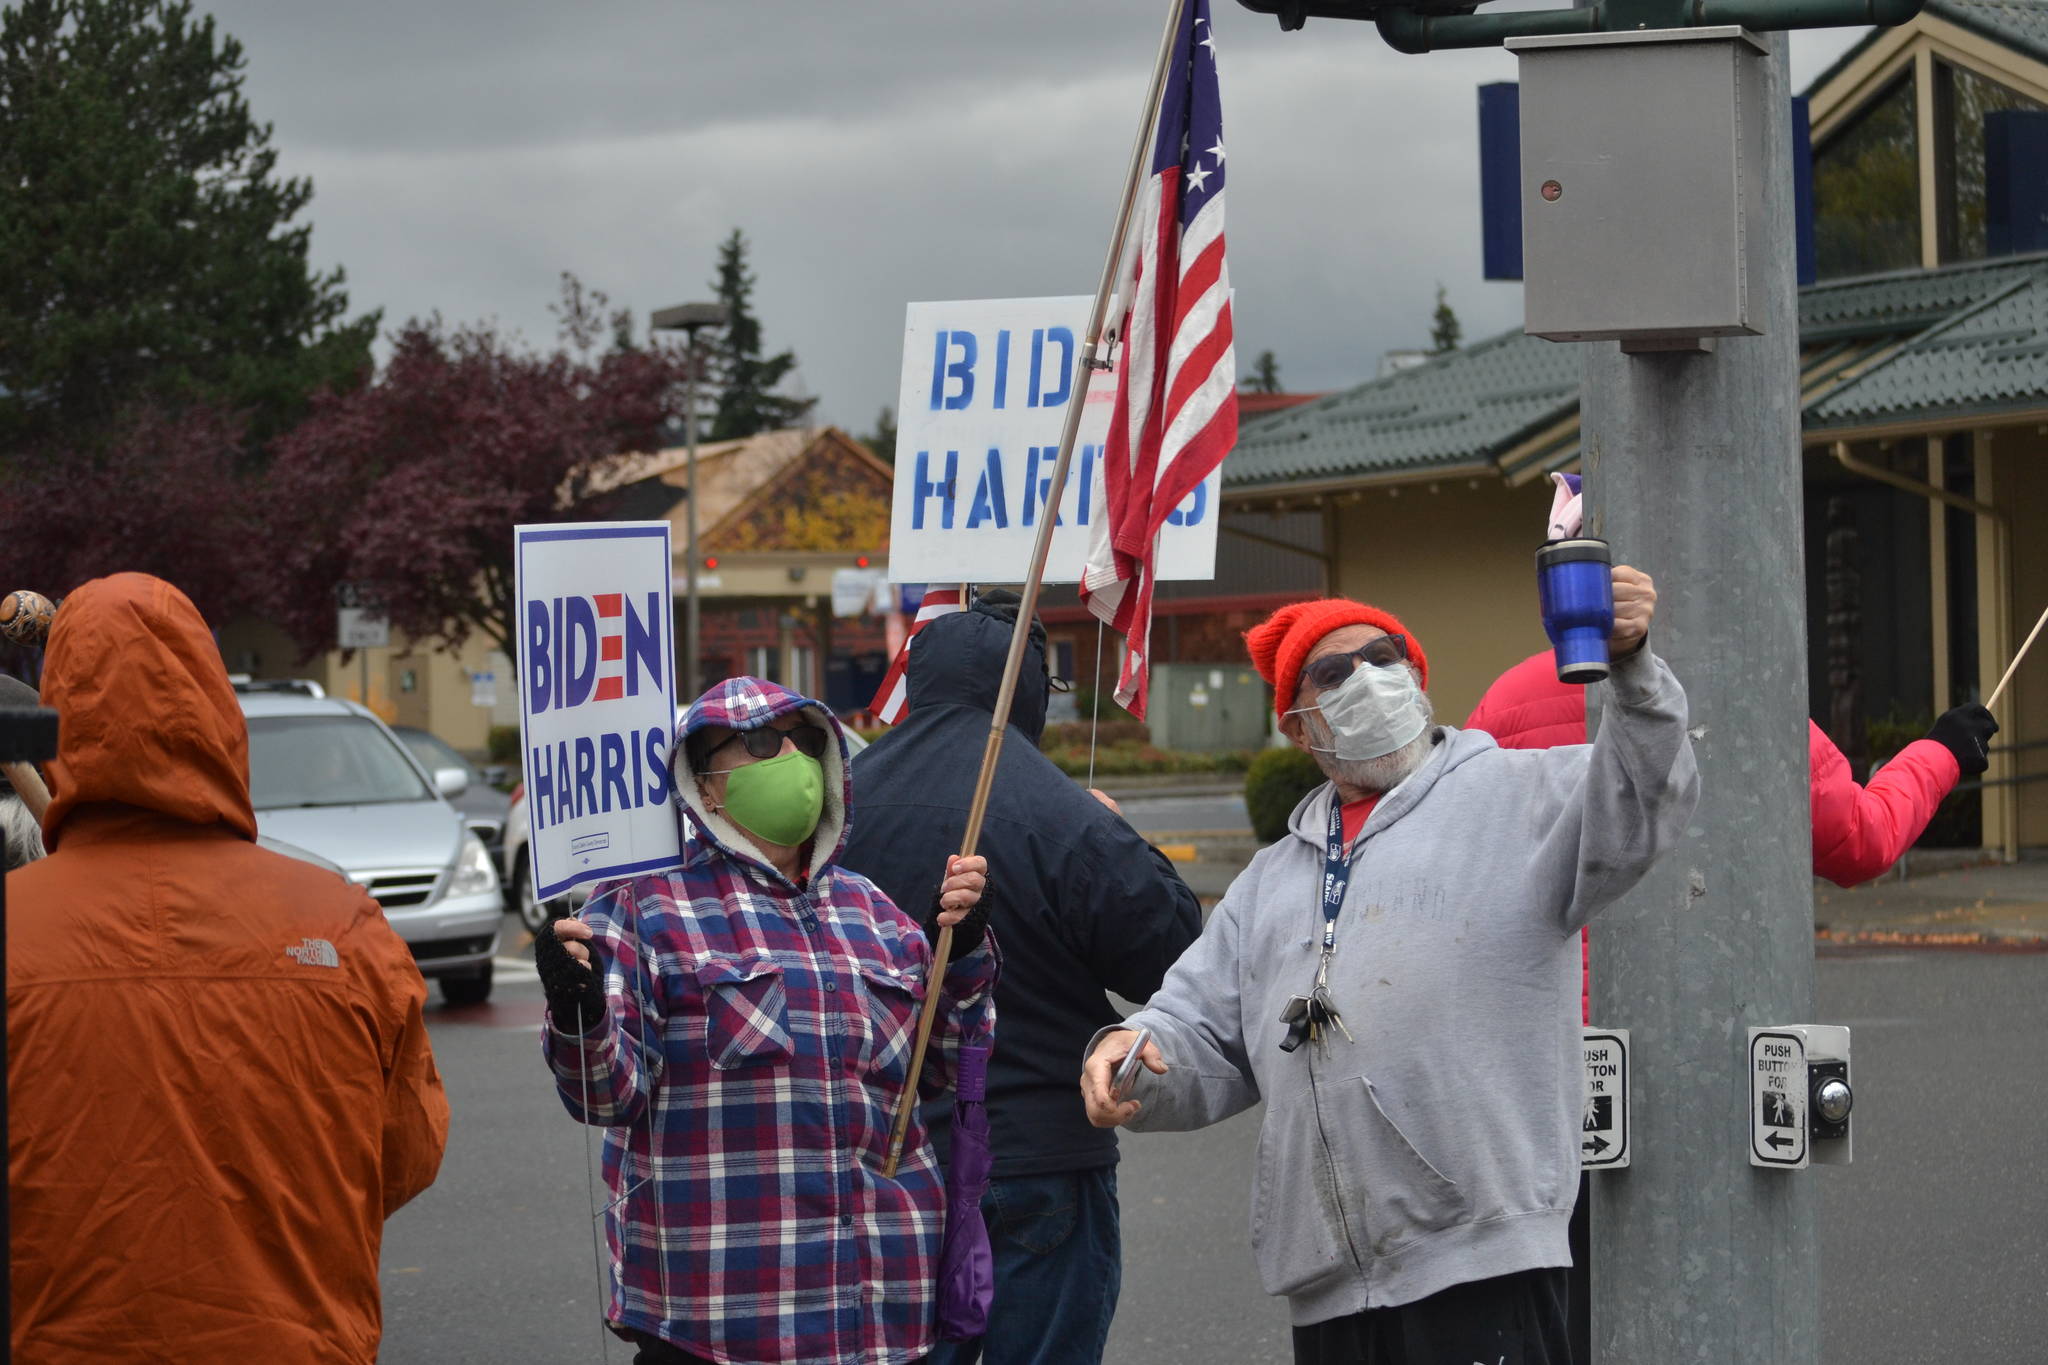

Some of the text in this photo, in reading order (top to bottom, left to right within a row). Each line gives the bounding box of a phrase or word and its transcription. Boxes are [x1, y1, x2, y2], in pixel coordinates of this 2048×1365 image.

[912, 443, 1207, 530] HAR
[528, 591, 663, 715] BIDEN
[533, 726, 669, 830] HARRIS
[302, 937, 321, 949] THE
[286, 945, 321, 958] NORTH
[1584, 1049, 1608, 1062] USH
[1764, 1044, 1791, 1058] PUSH
[1758, 1059, 1797, 1073] BUTTO
[1589, 1080, 1604, 1092] OR
